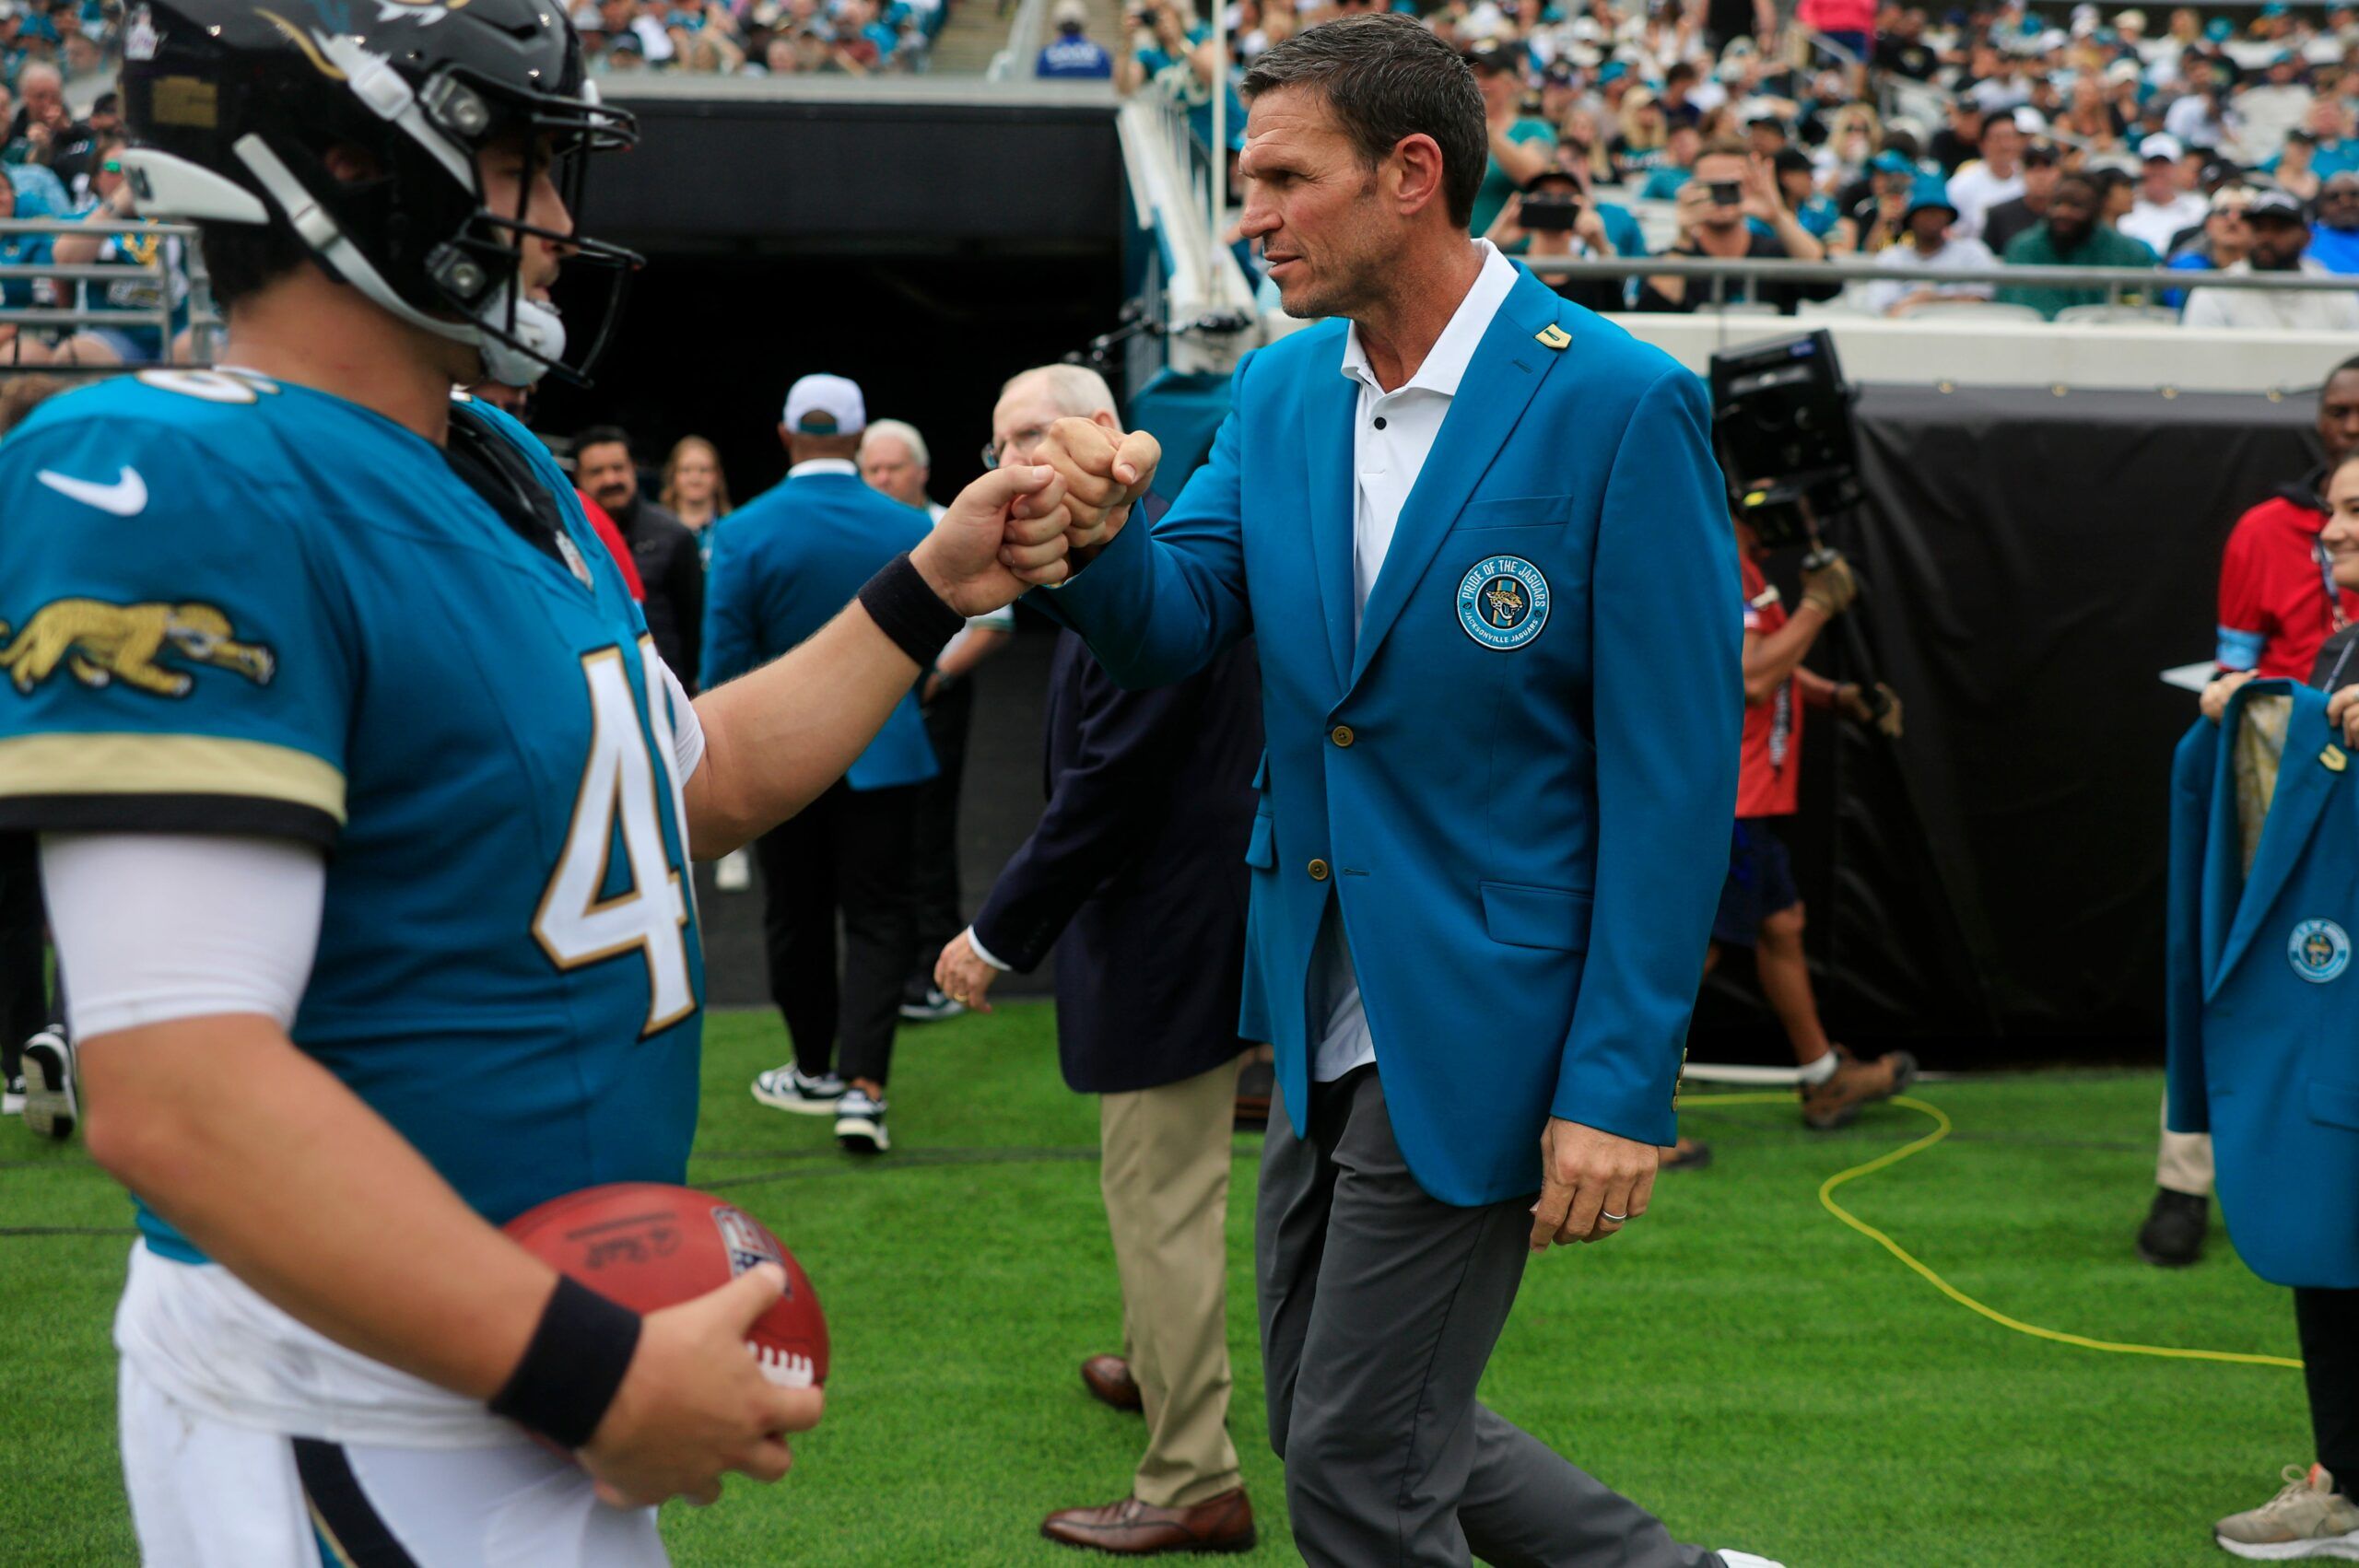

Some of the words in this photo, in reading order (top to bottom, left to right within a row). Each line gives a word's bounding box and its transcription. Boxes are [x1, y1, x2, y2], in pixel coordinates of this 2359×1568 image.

[1462, 570, 1484, 600] PRIDE
[1483, 561, 1495, 576] OF
[1498, 559, 1519, 573] THE
[1519, 566, 1545, 607] JAGUARS
[1465, 612, 1508, 642] JACKSONVILLE
[1511, 619, 1538, 642] JAGUARS
[532, 631, 704, 1041] 4
